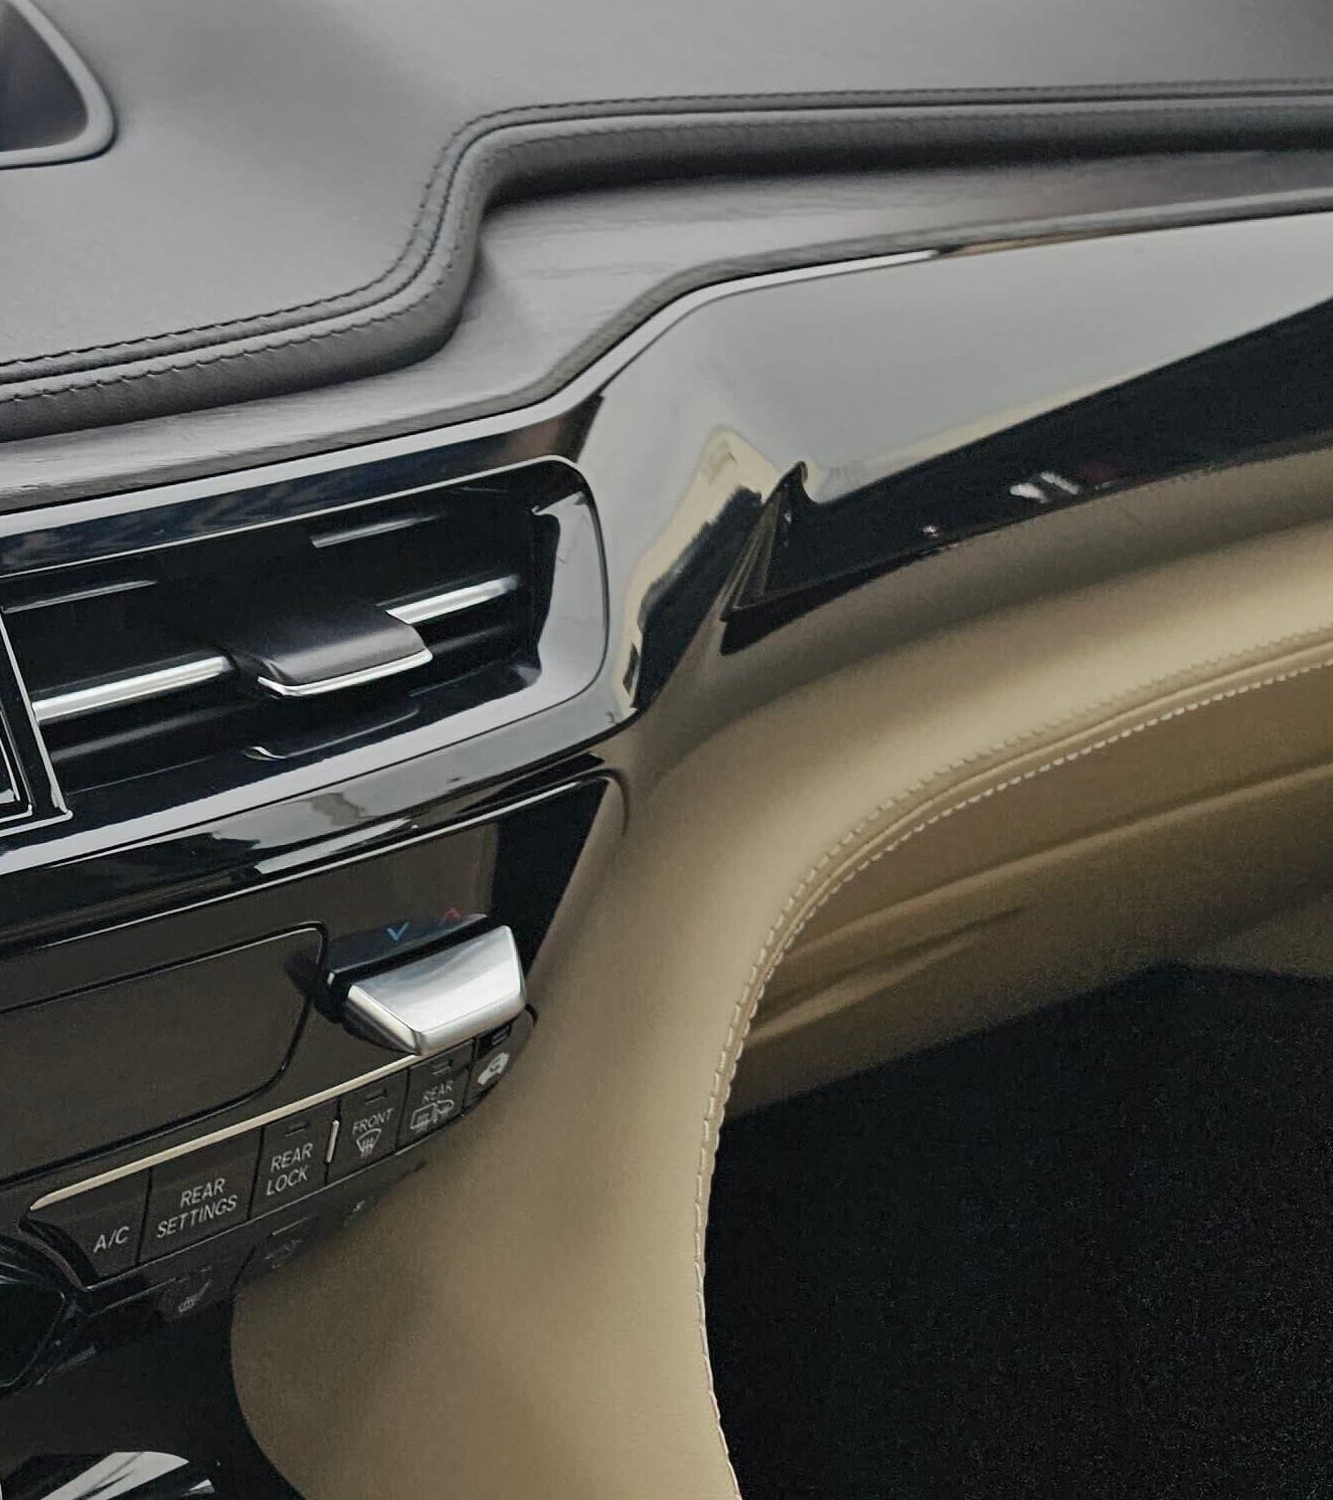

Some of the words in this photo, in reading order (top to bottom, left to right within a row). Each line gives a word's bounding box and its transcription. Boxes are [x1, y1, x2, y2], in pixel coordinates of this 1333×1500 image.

[351, 1108, 394, 1135] FRONT
[269, 1142, 314, 1172] REAR
[179, 1177, 226, 1209] REAR
[265, 1165, 309, 1197] LOCK
[156, 1194, 238, 1239] SETTINGS
[93, 1226, 130, 1253] A/C
